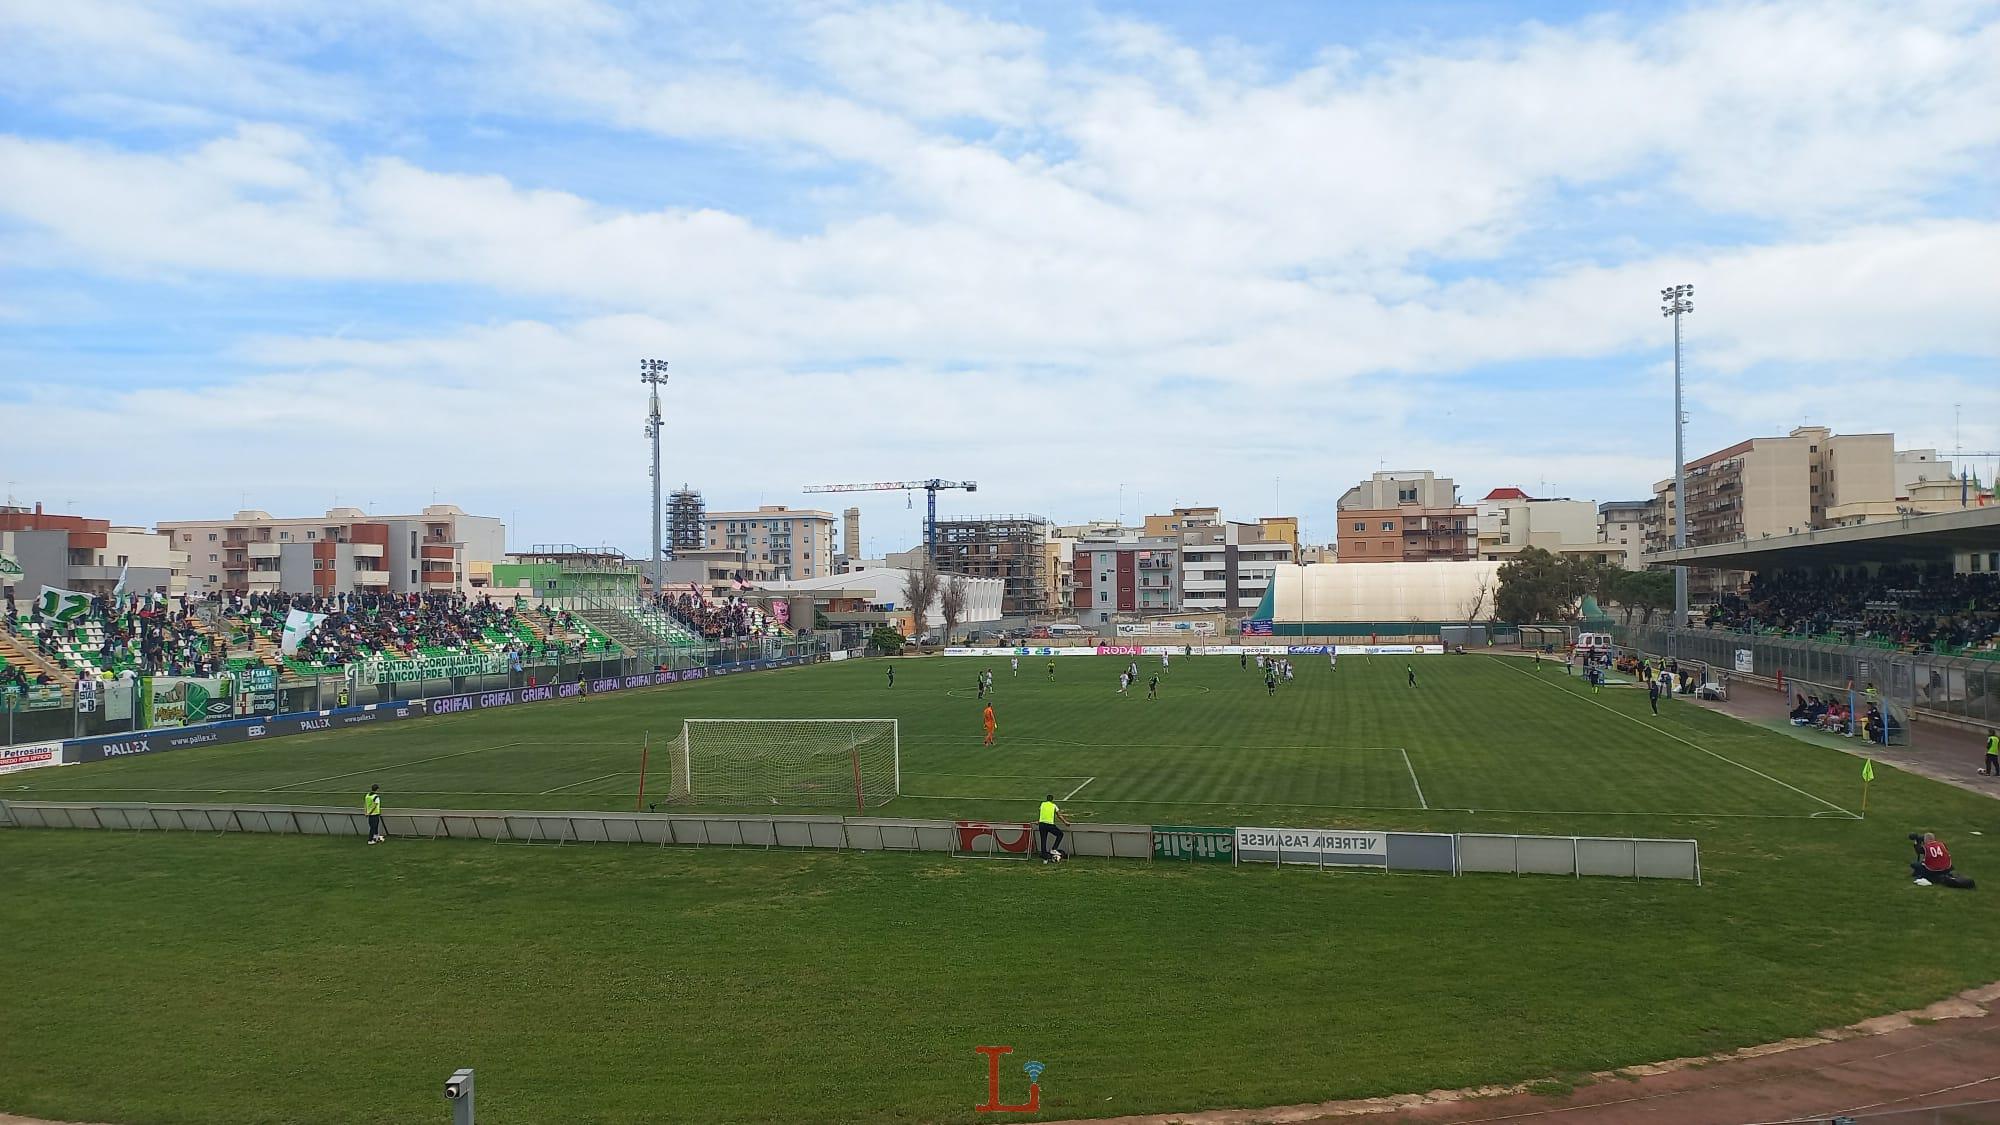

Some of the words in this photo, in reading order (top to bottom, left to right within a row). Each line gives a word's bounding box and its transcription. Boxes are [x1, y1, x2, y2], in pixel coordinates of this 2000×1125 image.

[376, 660, 414, 672] CENTRO
[416, 654, 489, 669] COORDINAMENTO
[379, 669, 443, 683] BIANCOVERDE
[445, 664, 488, 678] MONOPOLI
[87, 699, 95, 711] B
[103, 740, 150, 756] PALLEX
[300, 719, 331, 730] PALLEX
[1930, 846, 1943, 857] 04
